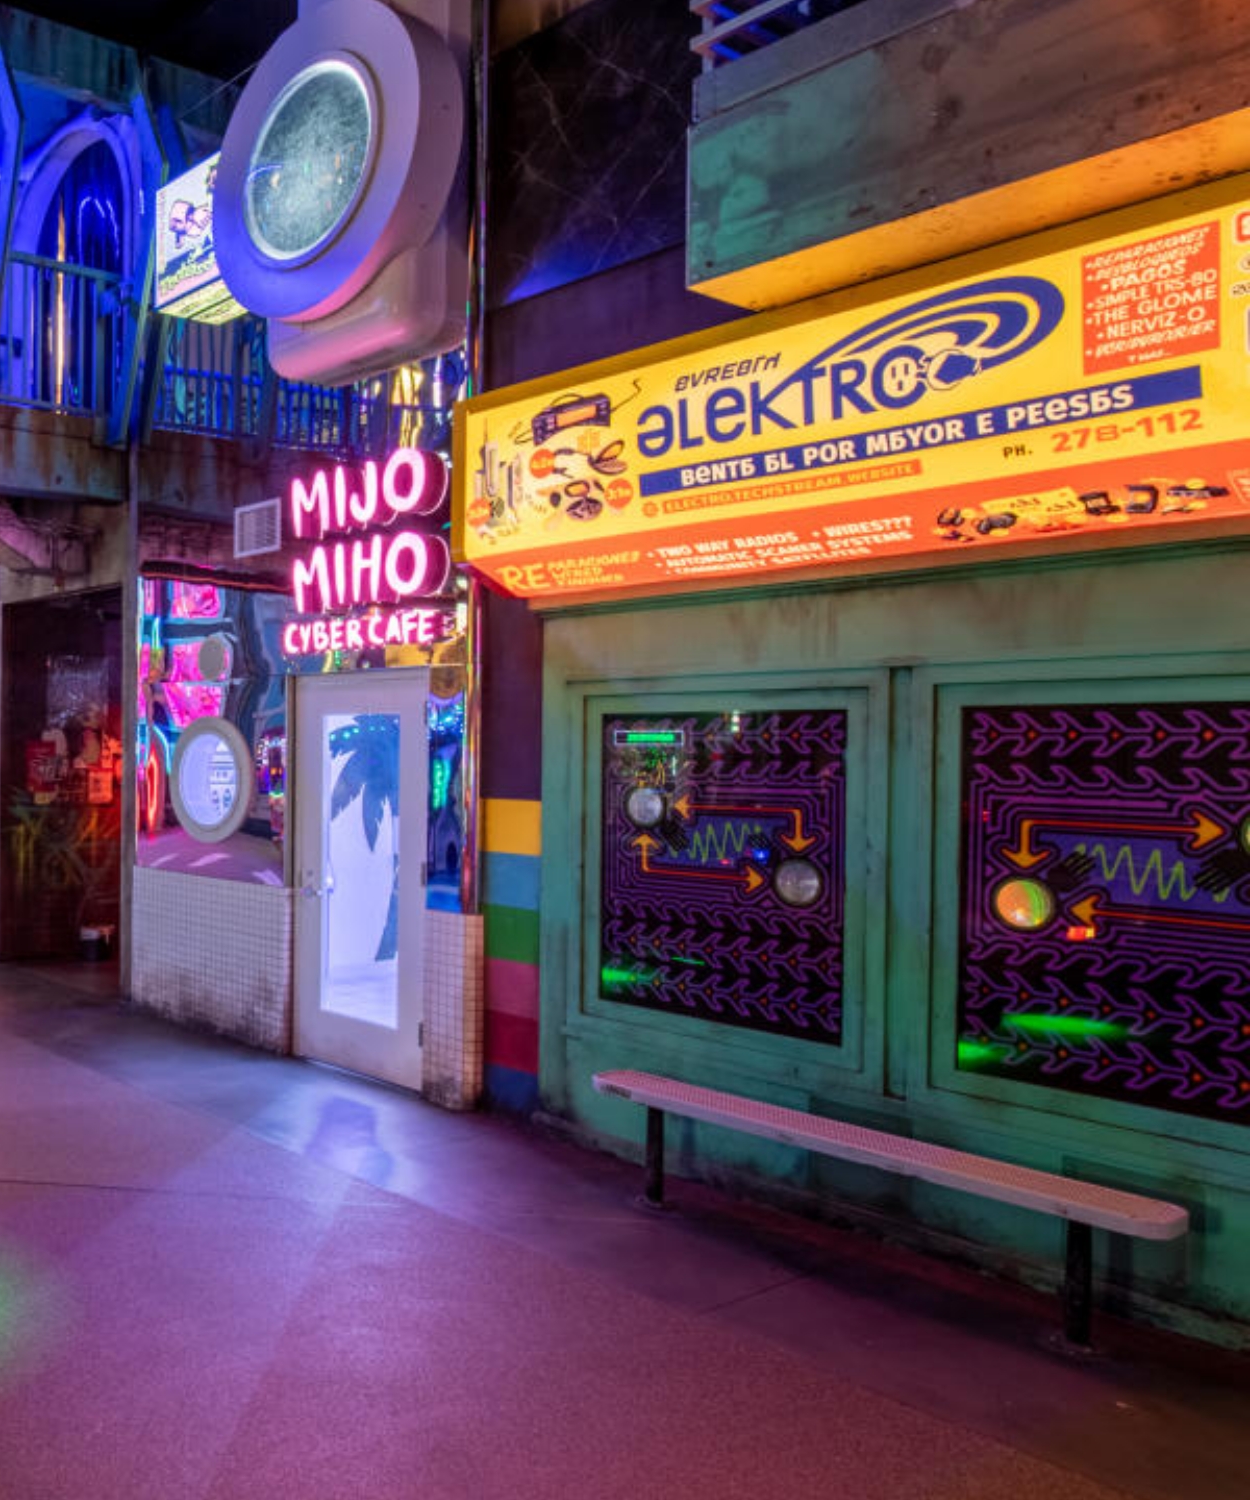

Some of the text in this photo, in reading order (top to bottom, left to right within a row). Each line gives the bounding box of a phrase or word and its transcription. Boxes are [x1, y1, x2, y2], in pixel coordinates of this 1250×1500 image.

[1110, 259, 1187, 290] PAGOS
[1093, 305, 1130, 326] THE
[1137, 284, 1218, 315] GLOME
[1096, 285, 1150, 309] SIMPLE
[1106, 306, 1206, 339] NERVIZ-O
[803, 440, 856, 467] POR
[1003, 445, 1034, 459] PH.
[291, 447, 426, 538] MIJO
[733, 531, 799, 550] RADIOS
[827, 531, 914, 550] SYSTEMS
[293, 531, 429, 614] MIHO
[496, 562, 550, 591] RE
[283, 609, 436, 653] CYBER CAFE
